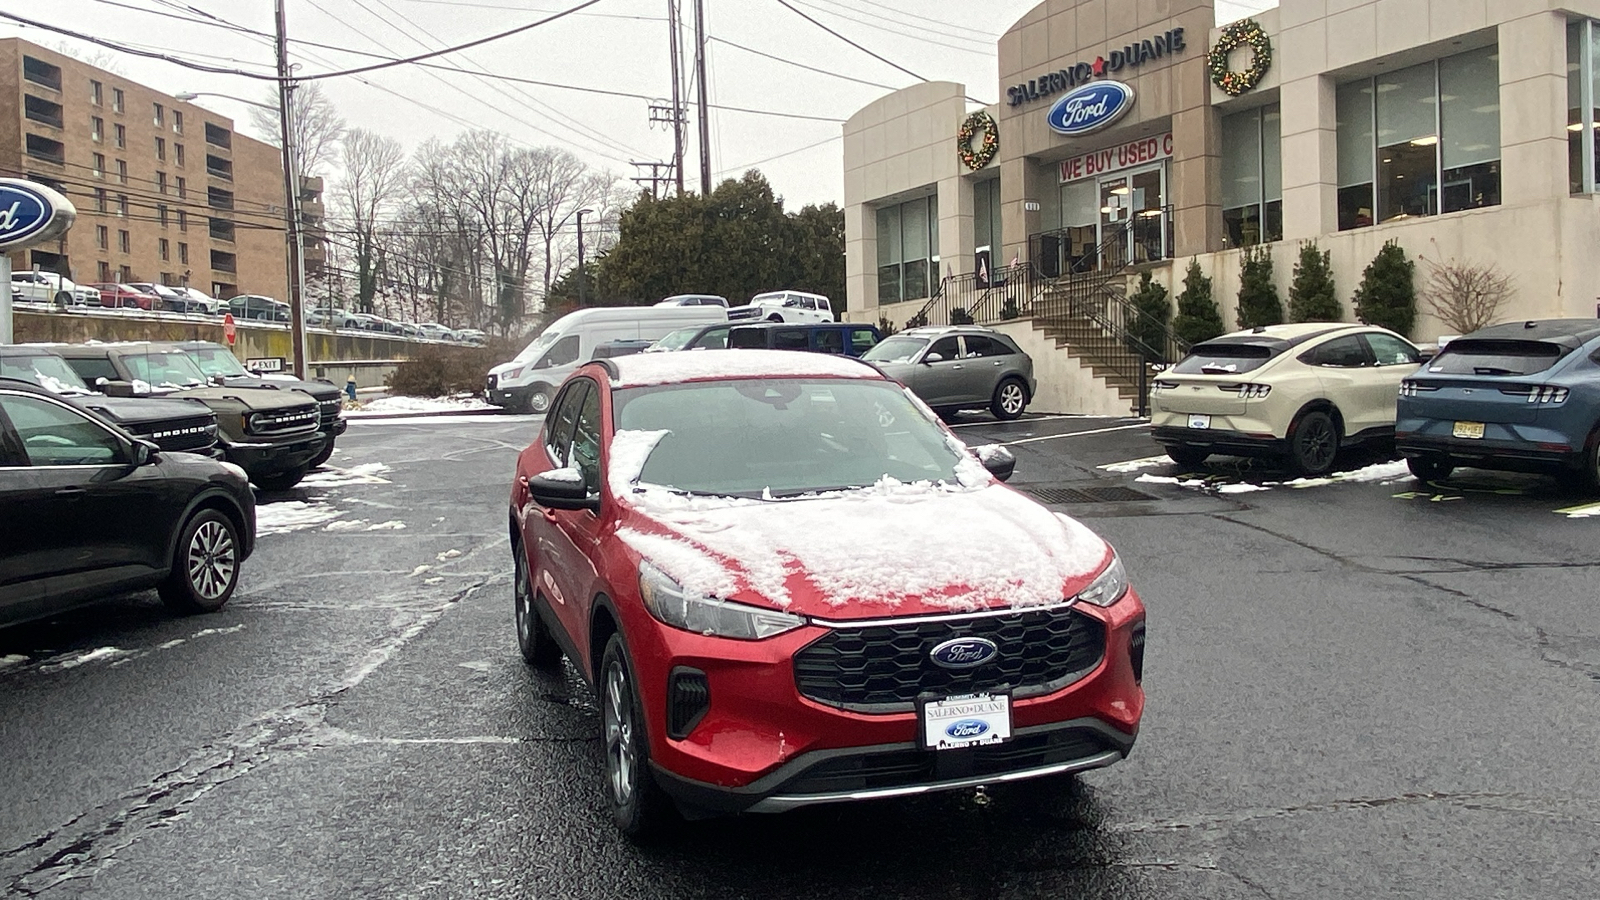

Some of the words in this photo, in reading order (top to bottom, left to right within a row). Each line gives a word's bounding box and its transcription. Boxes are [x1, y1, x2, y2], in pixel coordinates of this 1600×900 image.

[1007, 61, 1092, 106] SALERNO
[1109, 27, 1186, 72] DUANE
[1062, 92, 1108, 127] Ford
[1060, 159, 1082, 182] WE
[1086, 151, 1113, 175] BUY
[1118, 138, 1158, 167] USED
[258, 360, 277, 369] EXIT
[948, 644, 983, 661] Ford
[927, 706, 969, 718] SALERNO
[974, 702, 1005, 713] DUANE
[954, 722, 981, 735] Ford
